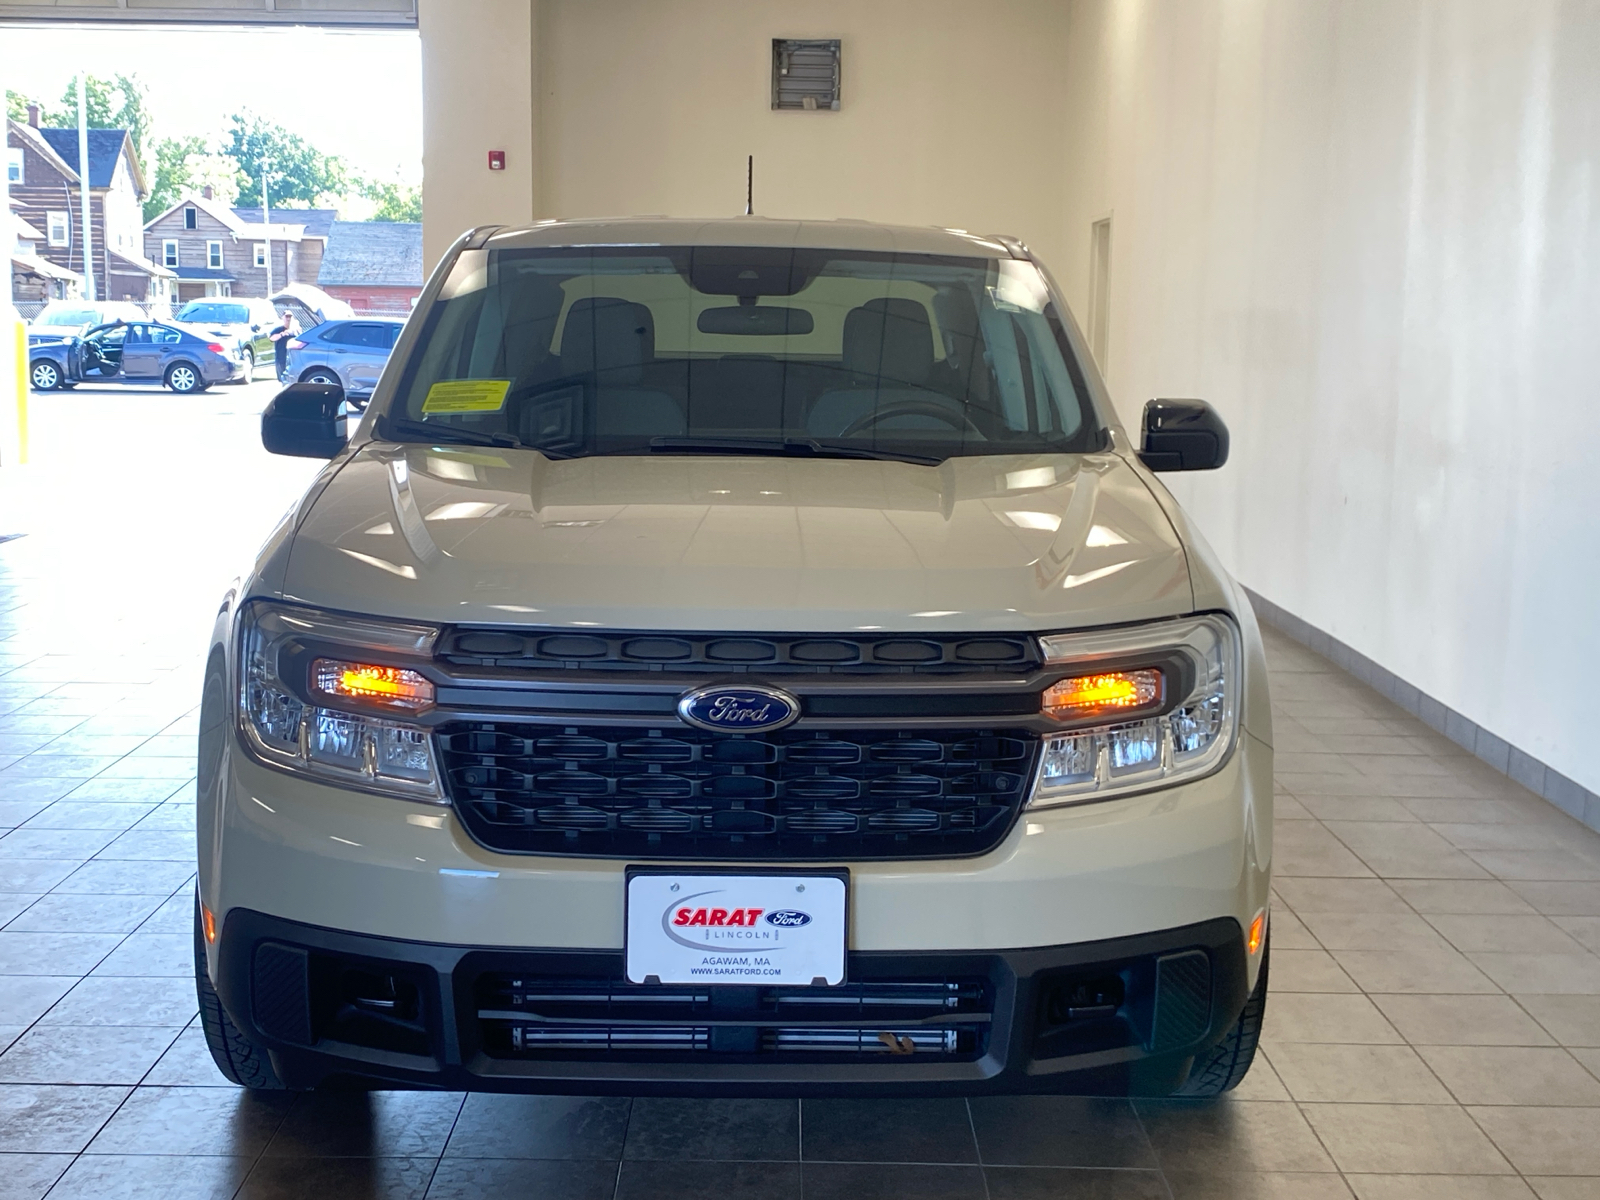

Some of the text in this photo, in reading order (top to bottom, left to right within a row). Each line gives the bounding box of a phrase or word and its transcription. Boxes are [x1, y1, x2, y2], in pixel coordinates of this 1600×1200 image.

[709, 696, 771, 721] Ford
[673, 907, 804, 928] SARAT Ford
[714, 931, 770, 939] LINCOLN
[702, 957, 771, 966] AGAWAM, MA
[691, 968, 782, 976] WWW.SARATFORD.COM
